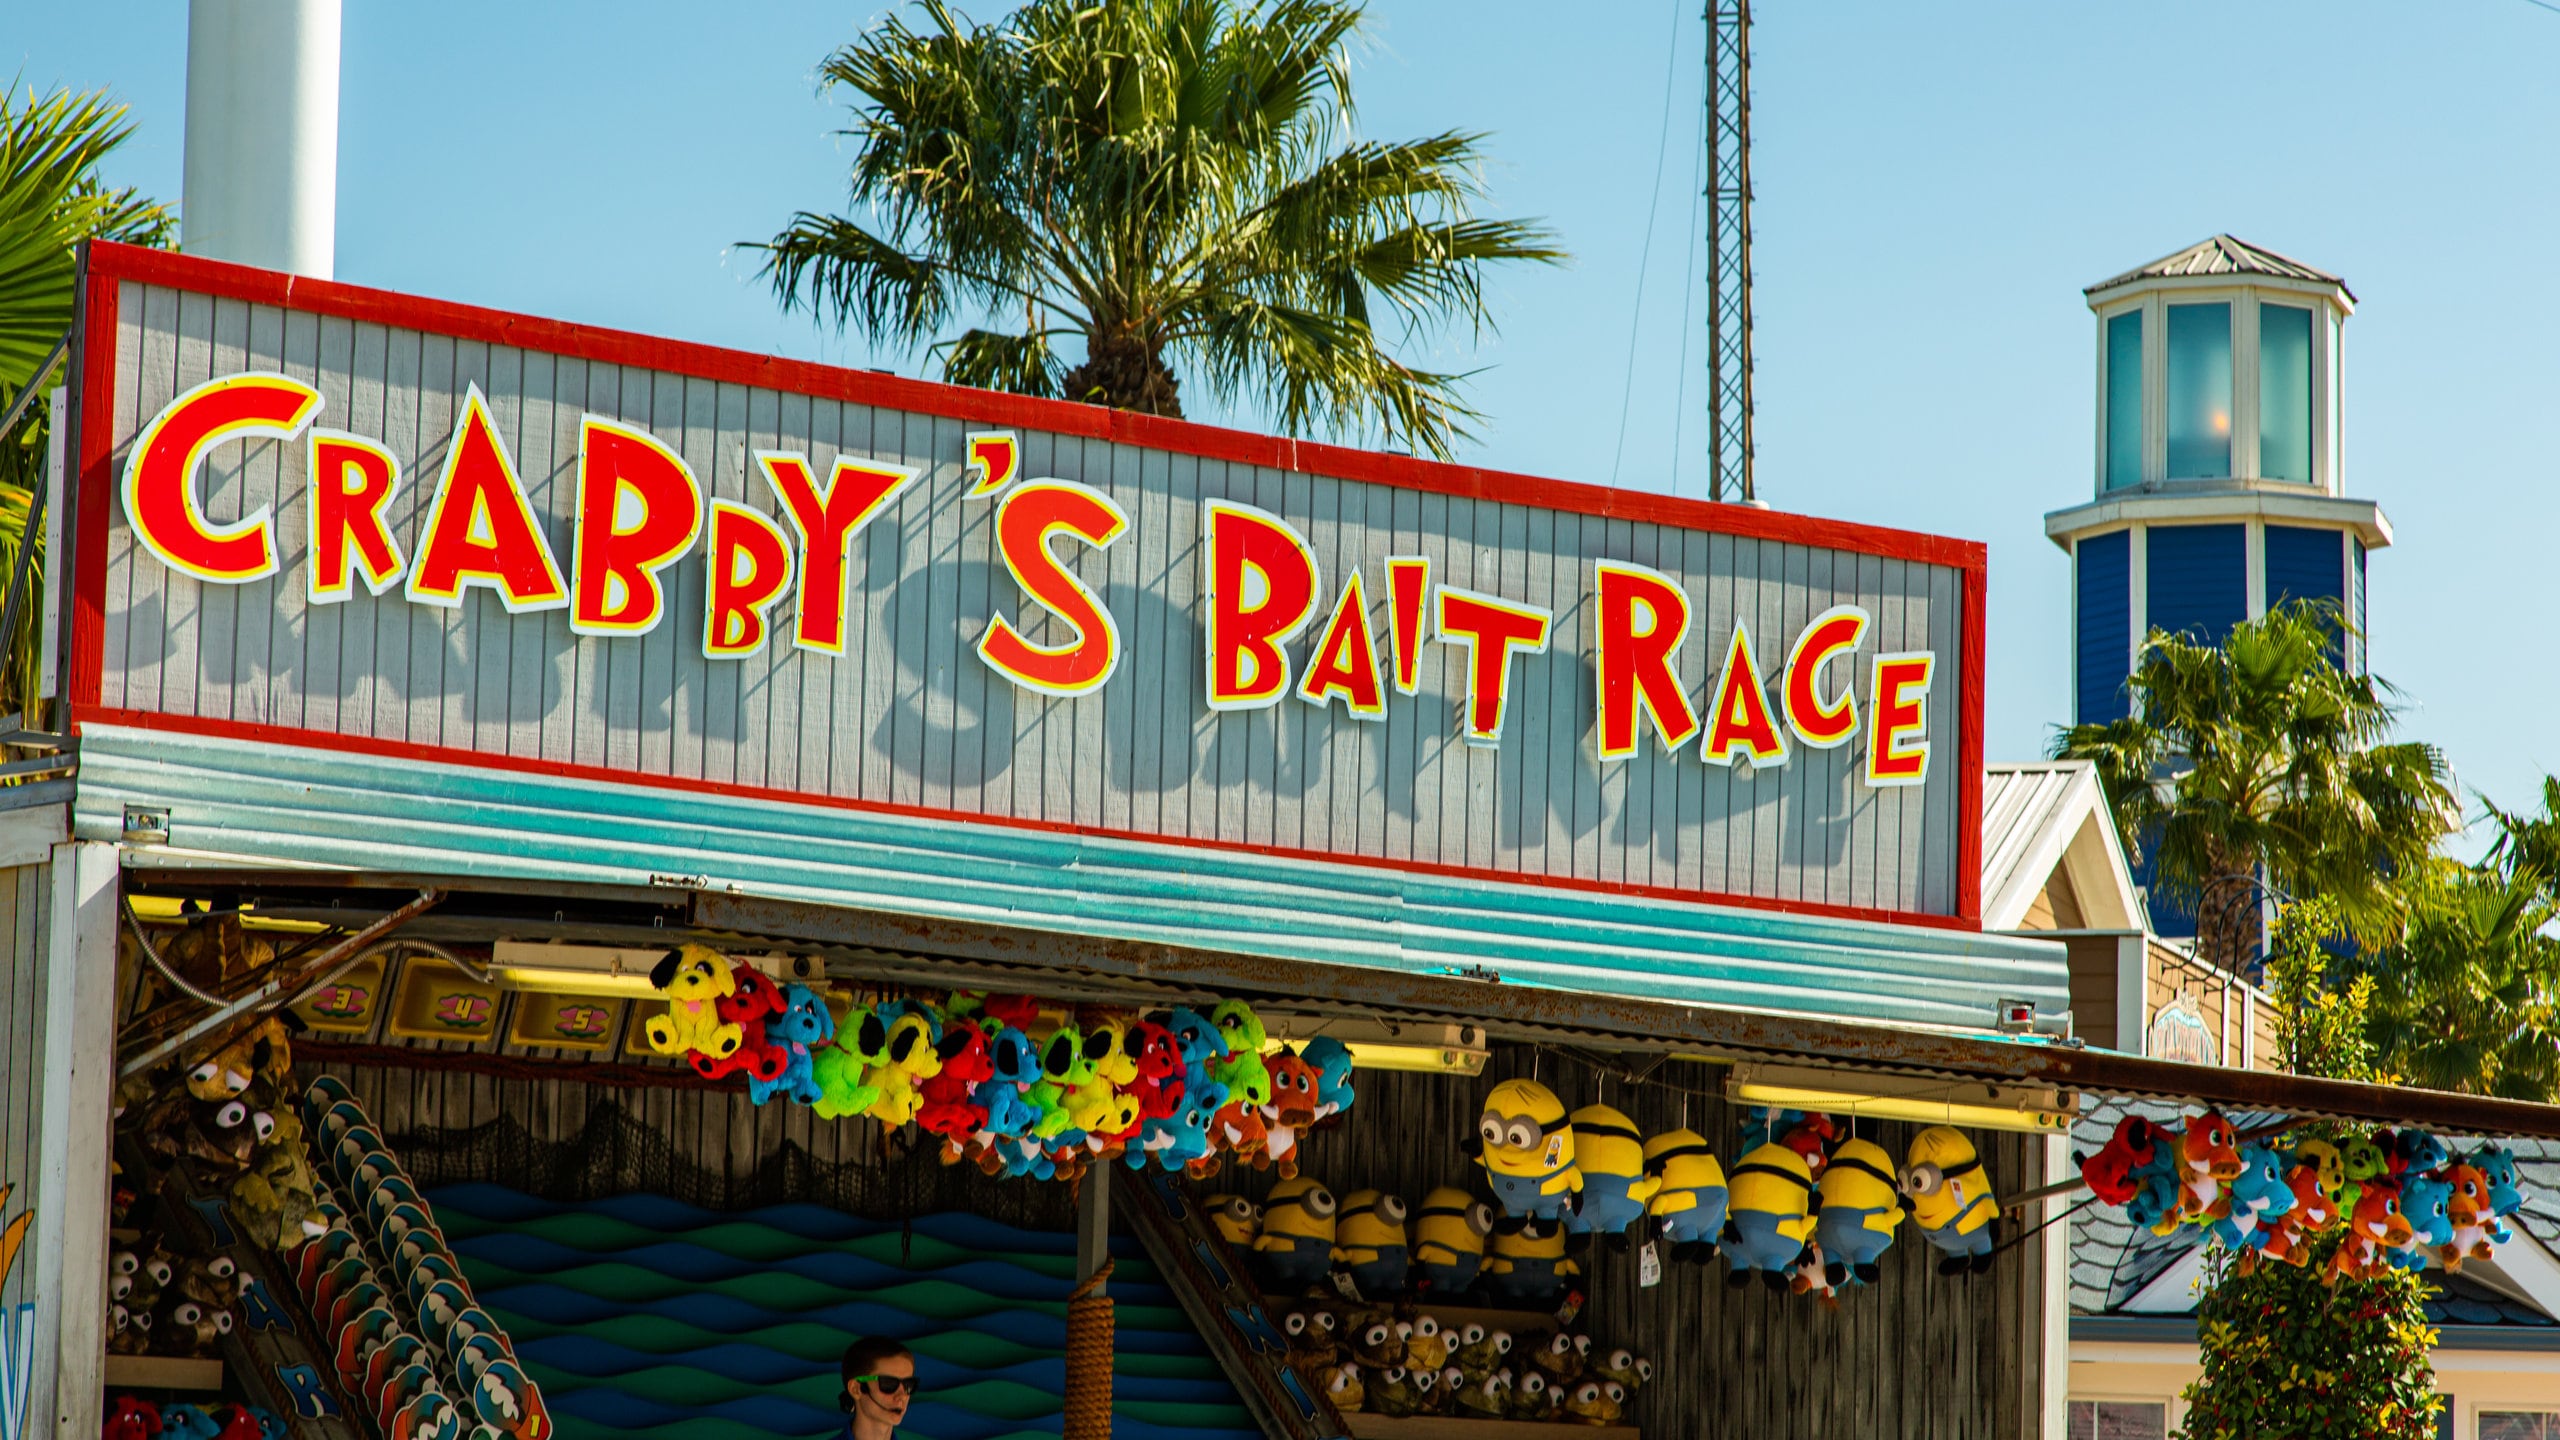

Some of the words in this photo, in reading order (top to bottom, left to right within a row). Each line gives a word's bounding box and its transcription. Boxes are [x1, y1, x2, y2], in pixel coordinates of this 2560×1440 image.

[122, 371, 1130, 698] CRABBY'S
[1204, 498, 1553, 749] BAIT
[1595, 558, 1936, 789] RACE
[331, 988, 353, 1010] 3
[454, 998, 475, 1021] 4
[572, 1009, 593, 1031] 5
